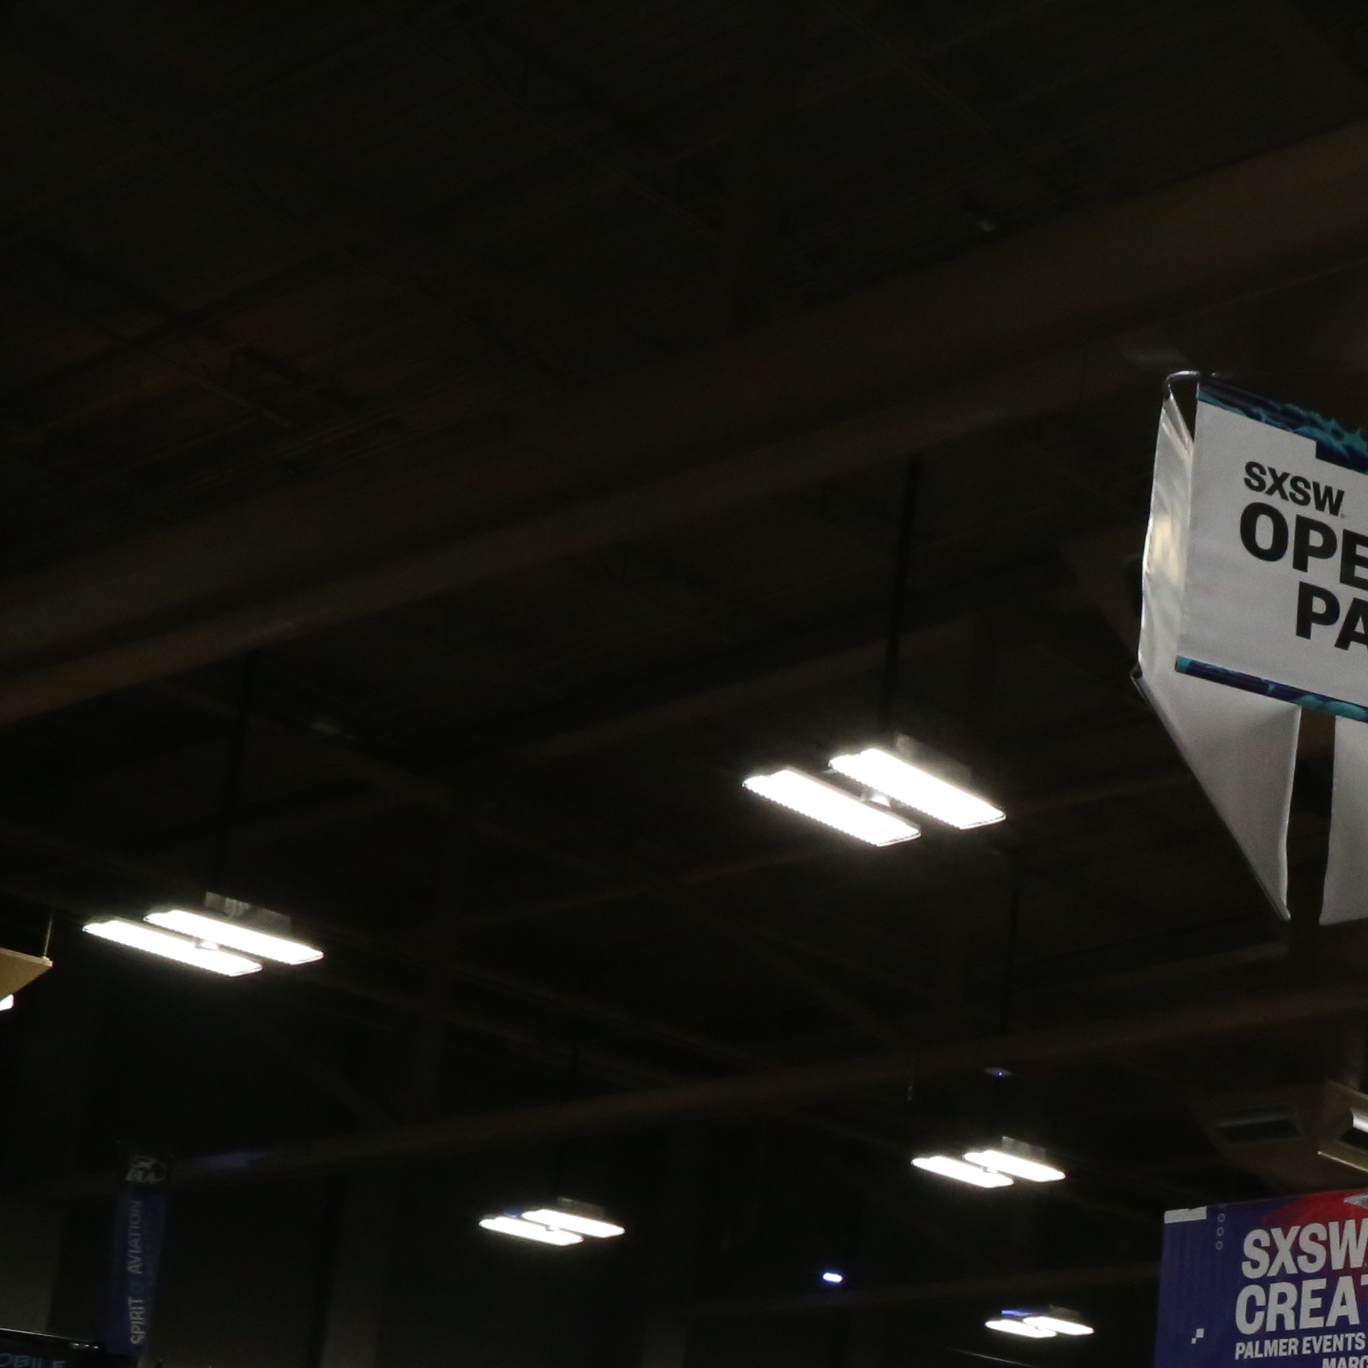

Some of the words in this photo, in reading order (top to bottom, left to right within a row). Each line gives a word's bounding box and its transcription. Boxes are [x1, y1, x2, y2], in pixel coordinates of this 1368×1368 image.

[1243, 461, 1345, 517] SXSW
[127, 1200, 143, 1275] AVIATION
[128, 1296, 146, 1345] SPIRIT
[1235, 1337, 1299, 1360] PALMER
[1302, 1332, 1365, 1355] EVENTS
